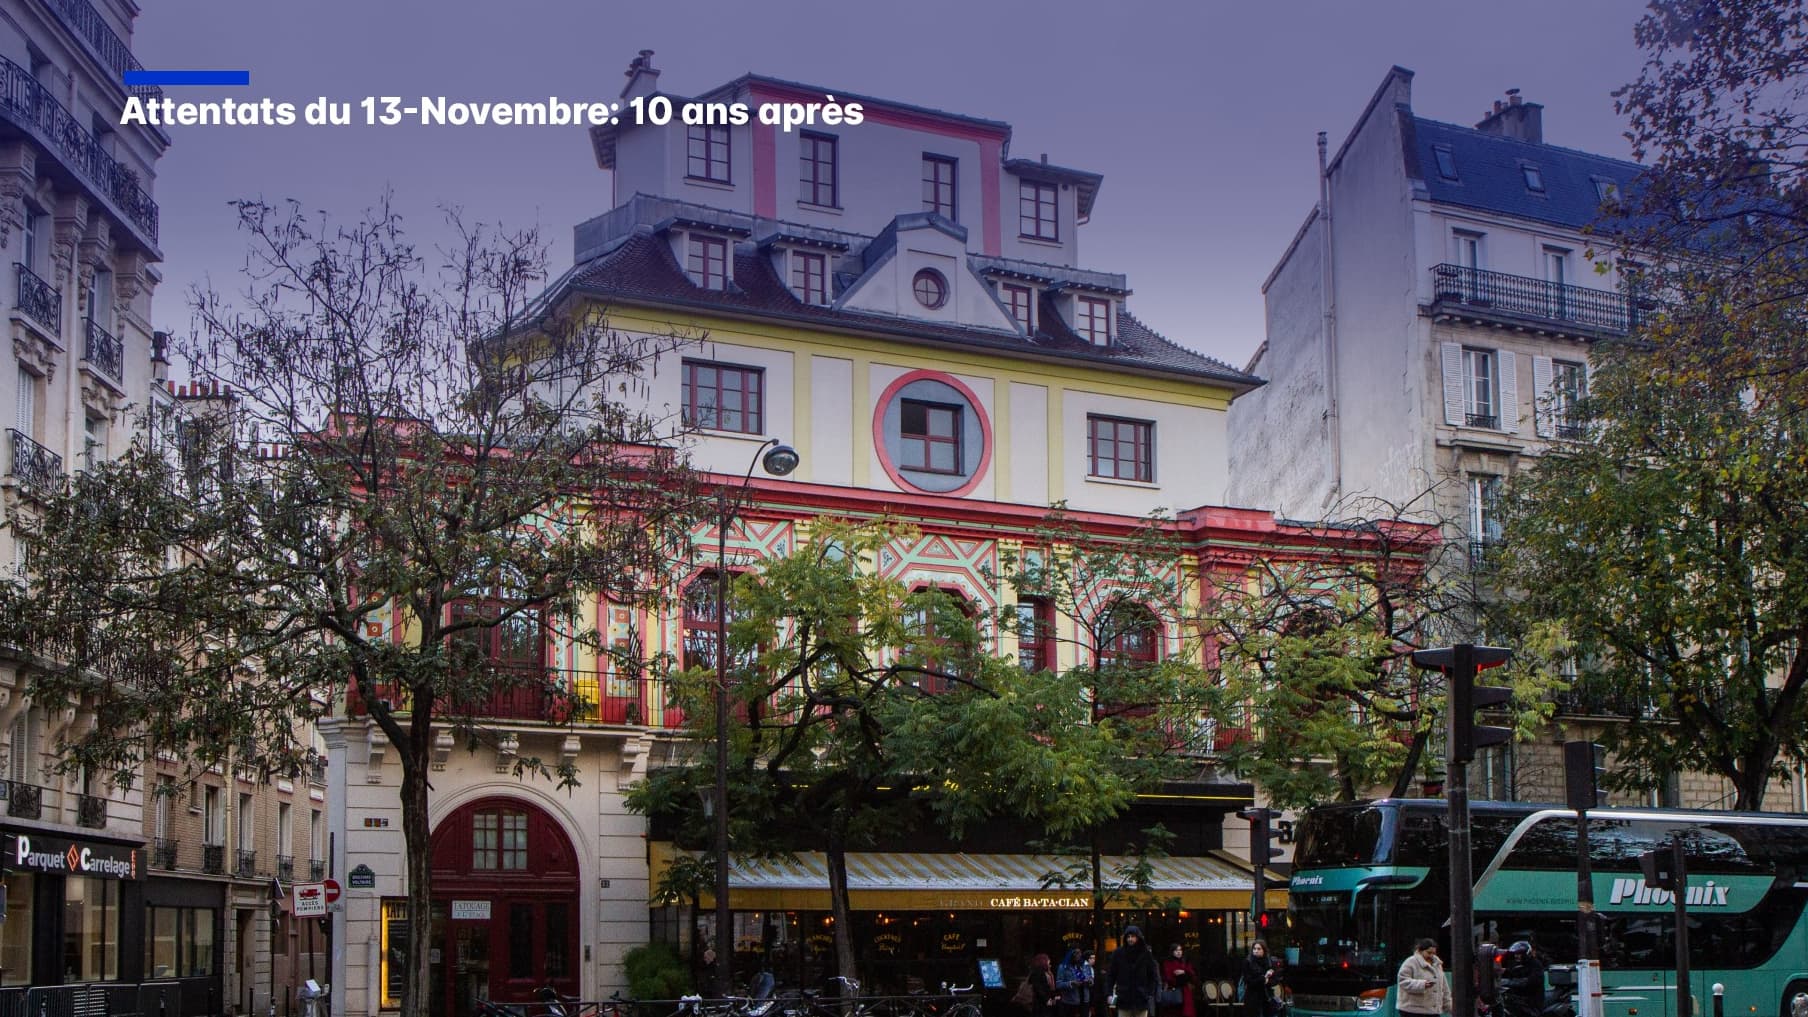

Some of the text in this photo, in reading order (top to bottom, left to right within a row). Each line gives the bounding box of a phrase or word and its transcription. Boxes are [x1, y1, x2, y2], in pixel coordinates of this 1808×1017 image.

[17, 835, 65, 872] Parquet
[81, 847, 130, 878] Carrelage
[990, 896, 1021, 907] CAFÉ
[1609, 878, 1731, 906] Phonix
